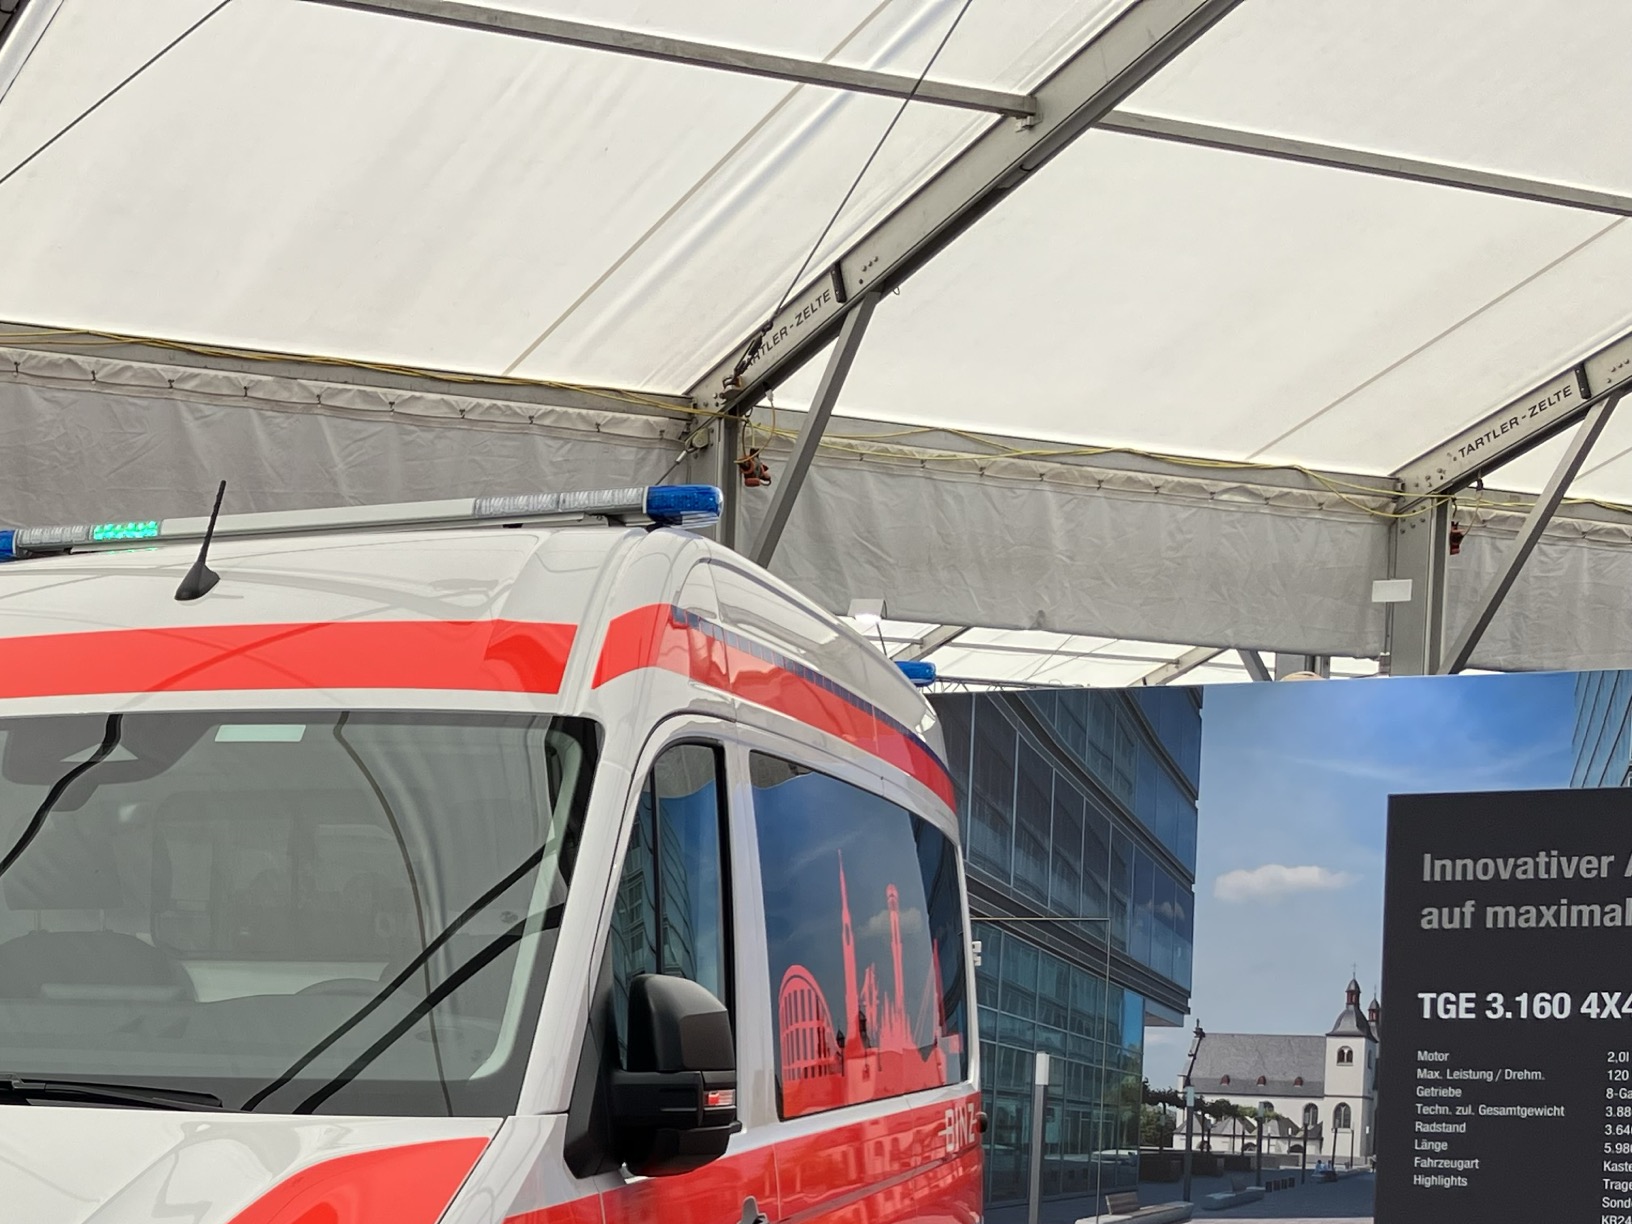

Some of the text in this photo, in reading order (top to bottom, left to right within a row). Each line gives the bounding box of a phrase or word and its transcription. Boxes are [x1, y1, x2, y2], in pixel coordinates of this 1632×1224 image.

[1422, 851, 1614, 882] Innovativer
[1420, 900, 1476, 930] auf
[1418, 992, 1476, 1019] TGE
[1485, 992, 1570, 1019] 3.160
[1417, 1050, 1449, 1061] Motor
[1417, 1068, 1442, 1079] Max.
[1447, 1069, 1493, 1082] Leistung
[1505, 1069, 1545, 1080] Drehm.
[1607, 1069, 1629, 1080] 120
[1416, 1086, 1462, 1097] Getriebe
[1416, 1104, 1565, 1118] Techn. zul. Gesamtgewicht
[1415, 1121, 1465, 1132] Radstand
[1414, 1139, 1447, 1152] Länge
[1414, 1157, 1479, 1169] Fahrzeugart
[1413, 1175, 1467, 1187] Highlights
[1602, 1197, 1632, 1208] Sond
